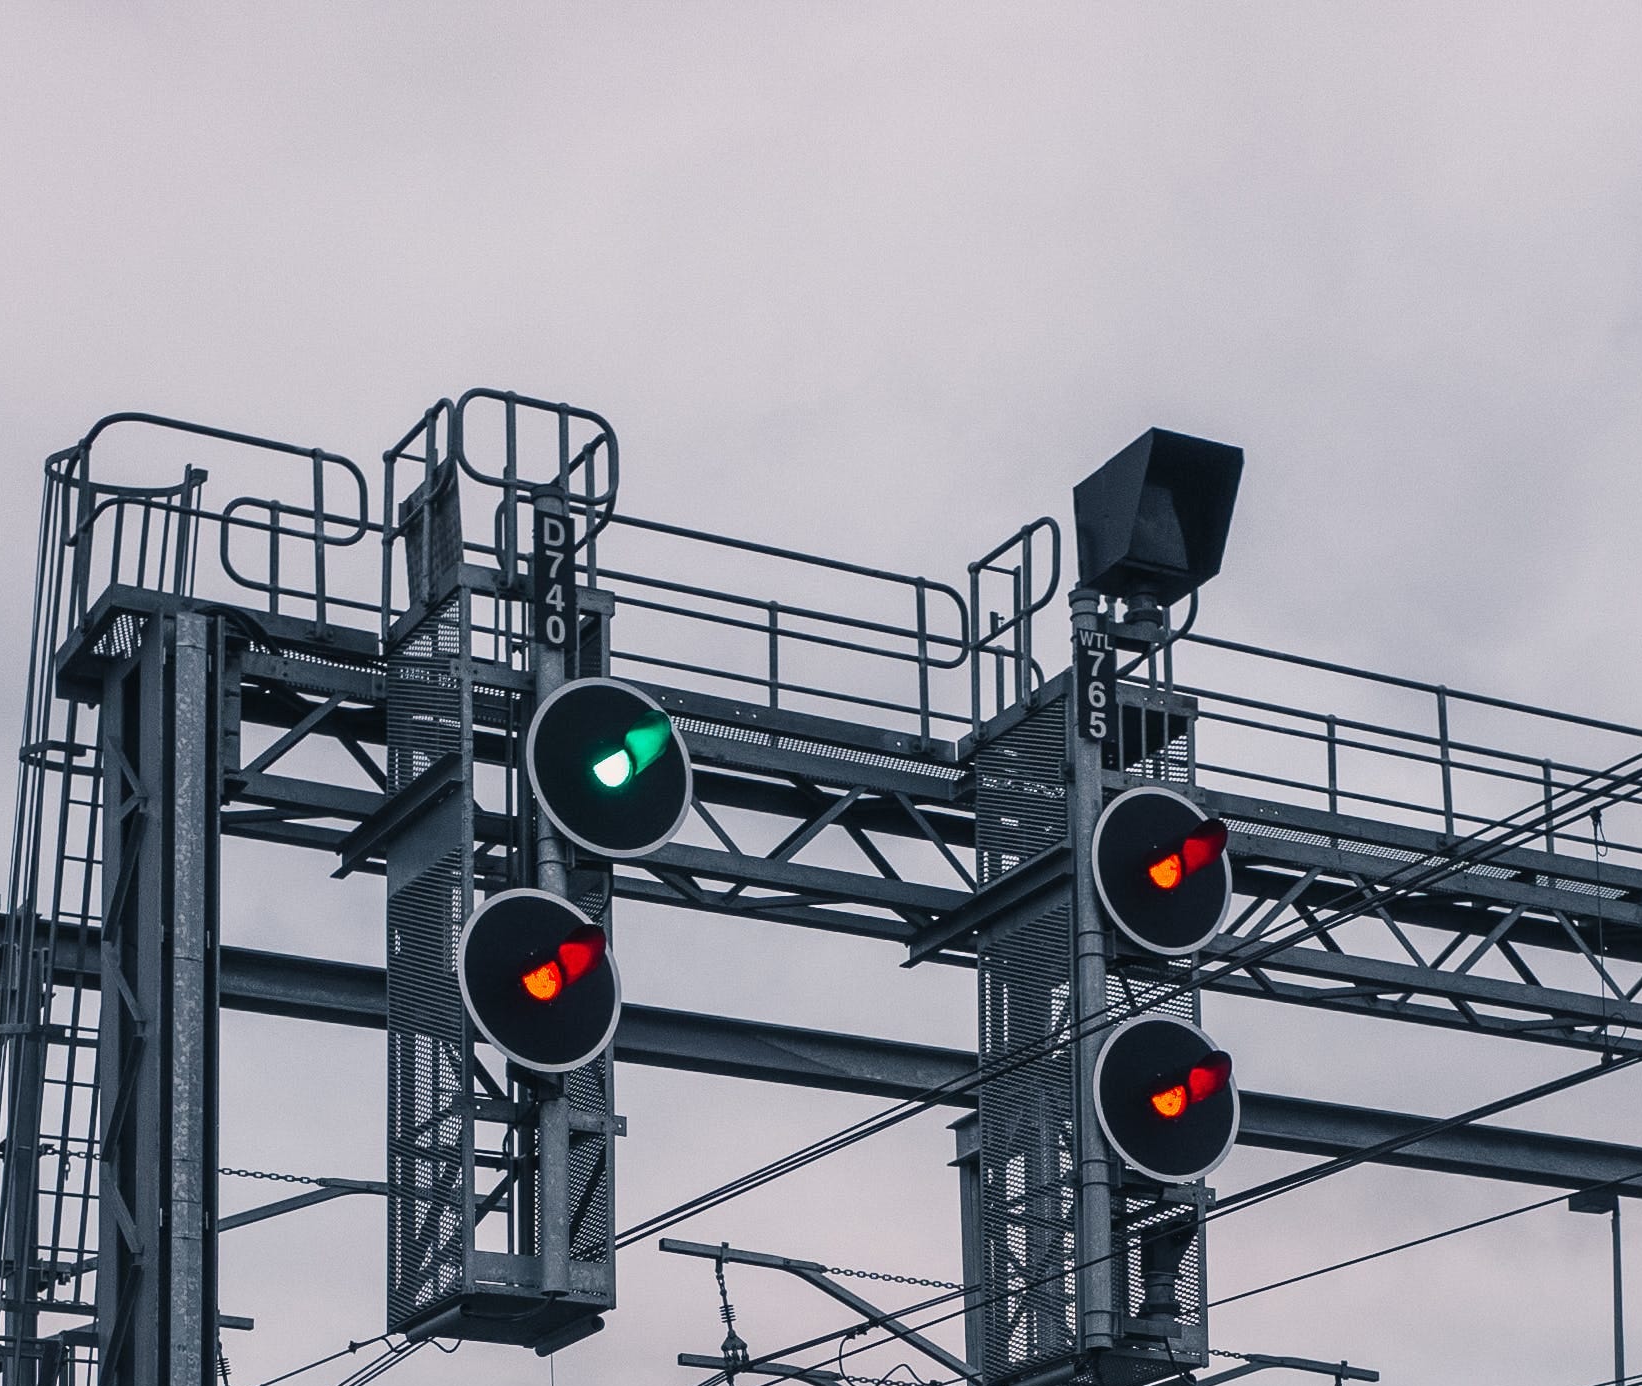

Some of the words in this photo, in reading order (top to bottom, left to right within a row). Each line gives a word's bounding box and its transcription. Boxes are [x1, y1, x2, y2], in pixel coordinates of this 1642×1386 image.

[543, 517, 566, 644] D740
[1079, 631, 1114, 650] WTL
[1087, 652, 1108, 738] 765
